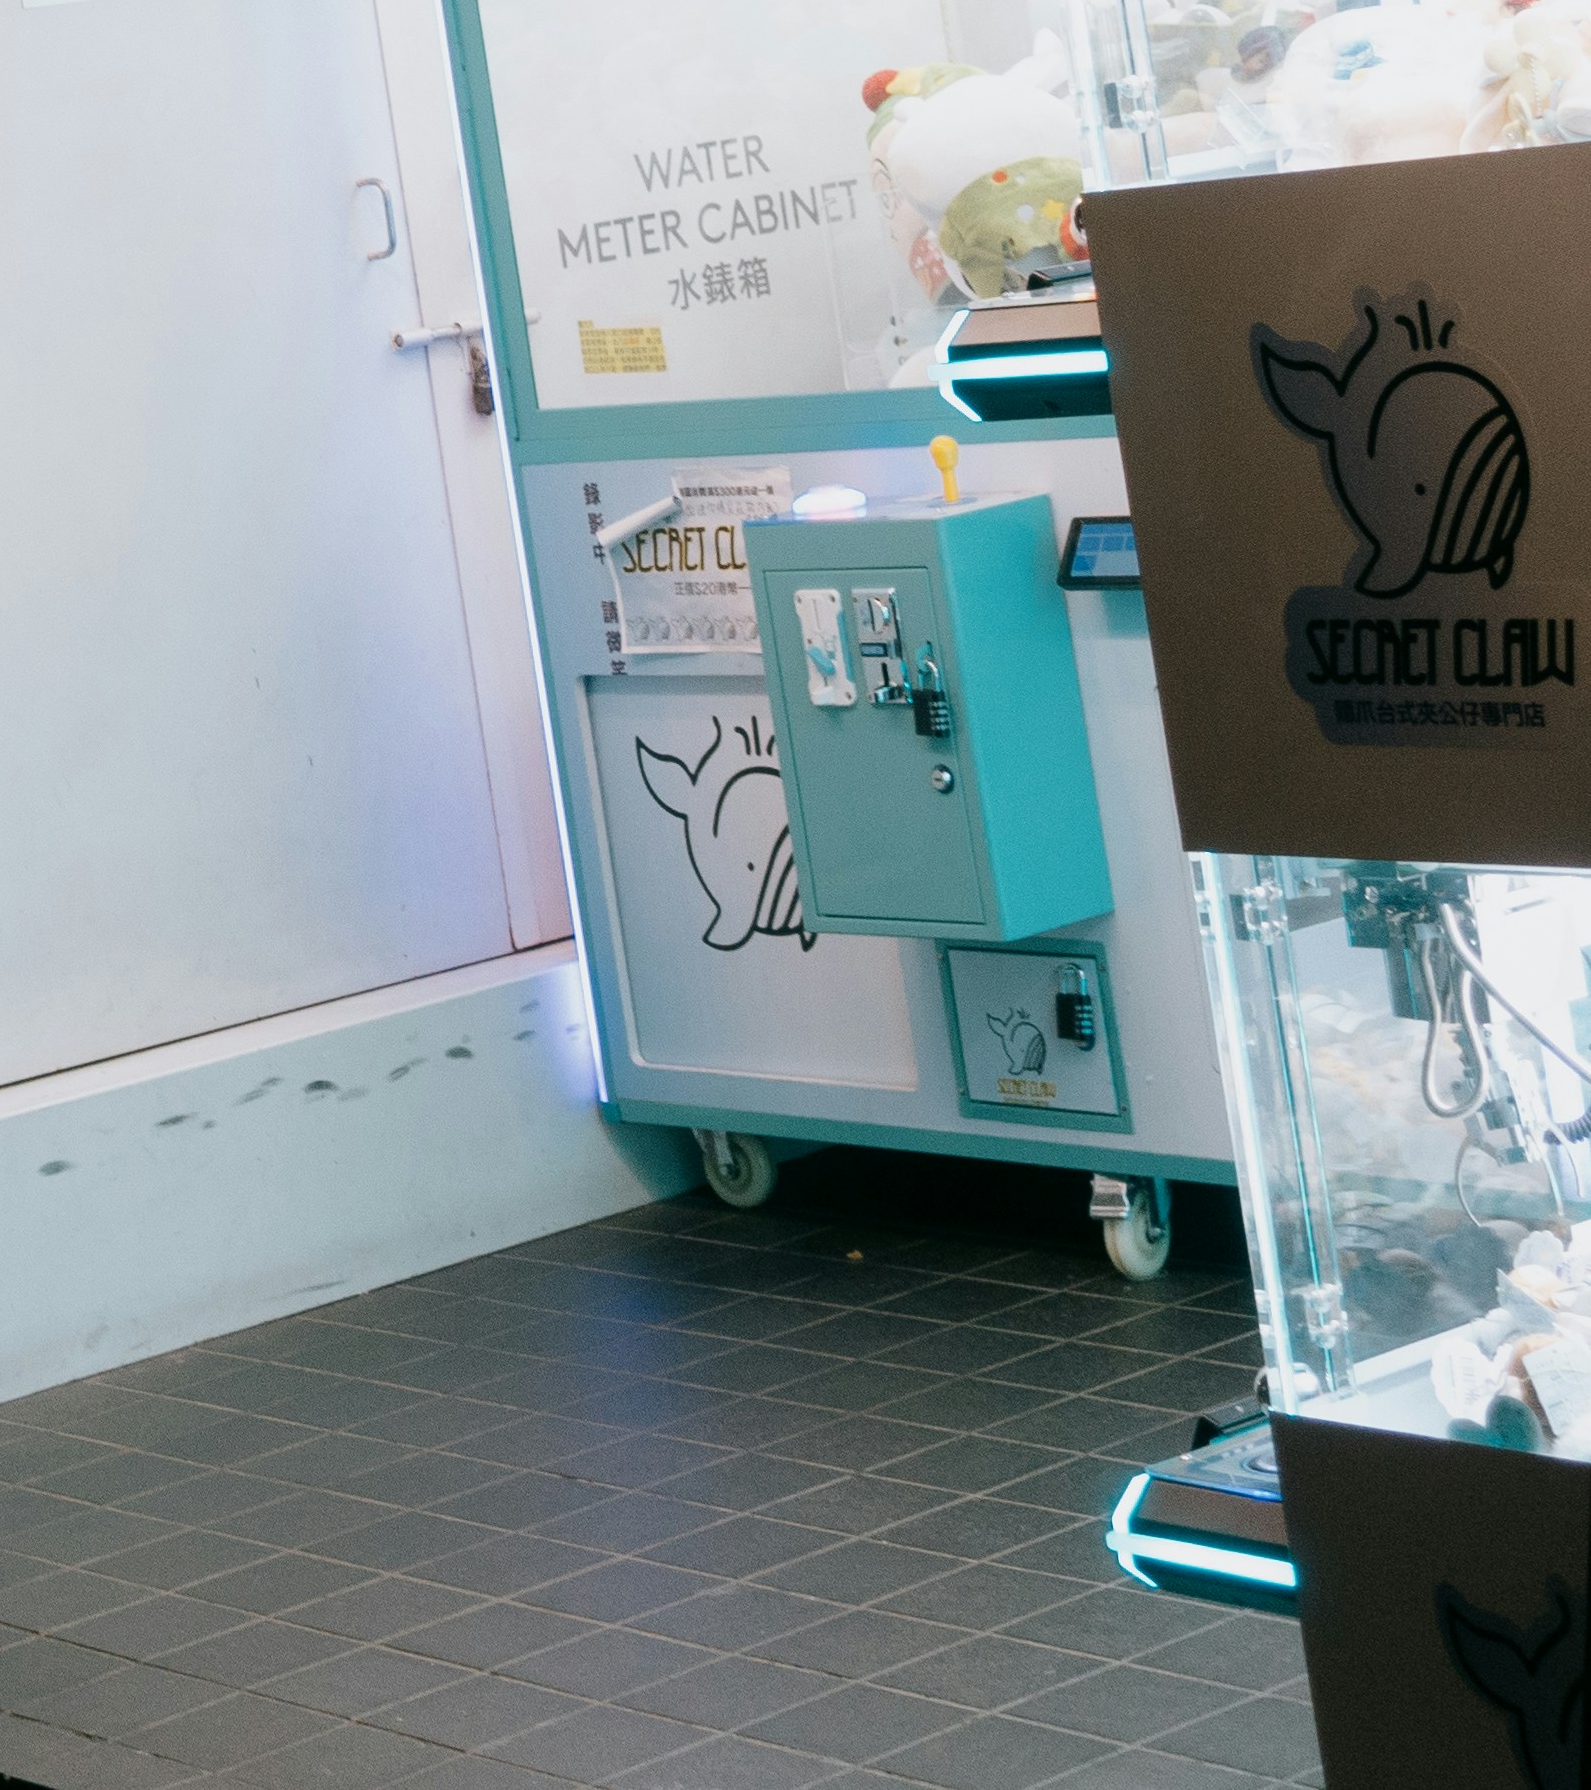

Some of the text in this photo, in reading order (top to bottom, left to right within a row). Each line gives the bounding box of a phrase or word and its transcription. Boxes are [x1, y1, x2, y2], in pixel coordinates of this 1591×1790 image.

[633, 134, 770, 192] WATER
[558, 179, 859, 269] METER CABINET
[622, 525, 747, 573] SECRET CL
[1305, 617, 1574, 687] SECRET CLAW
